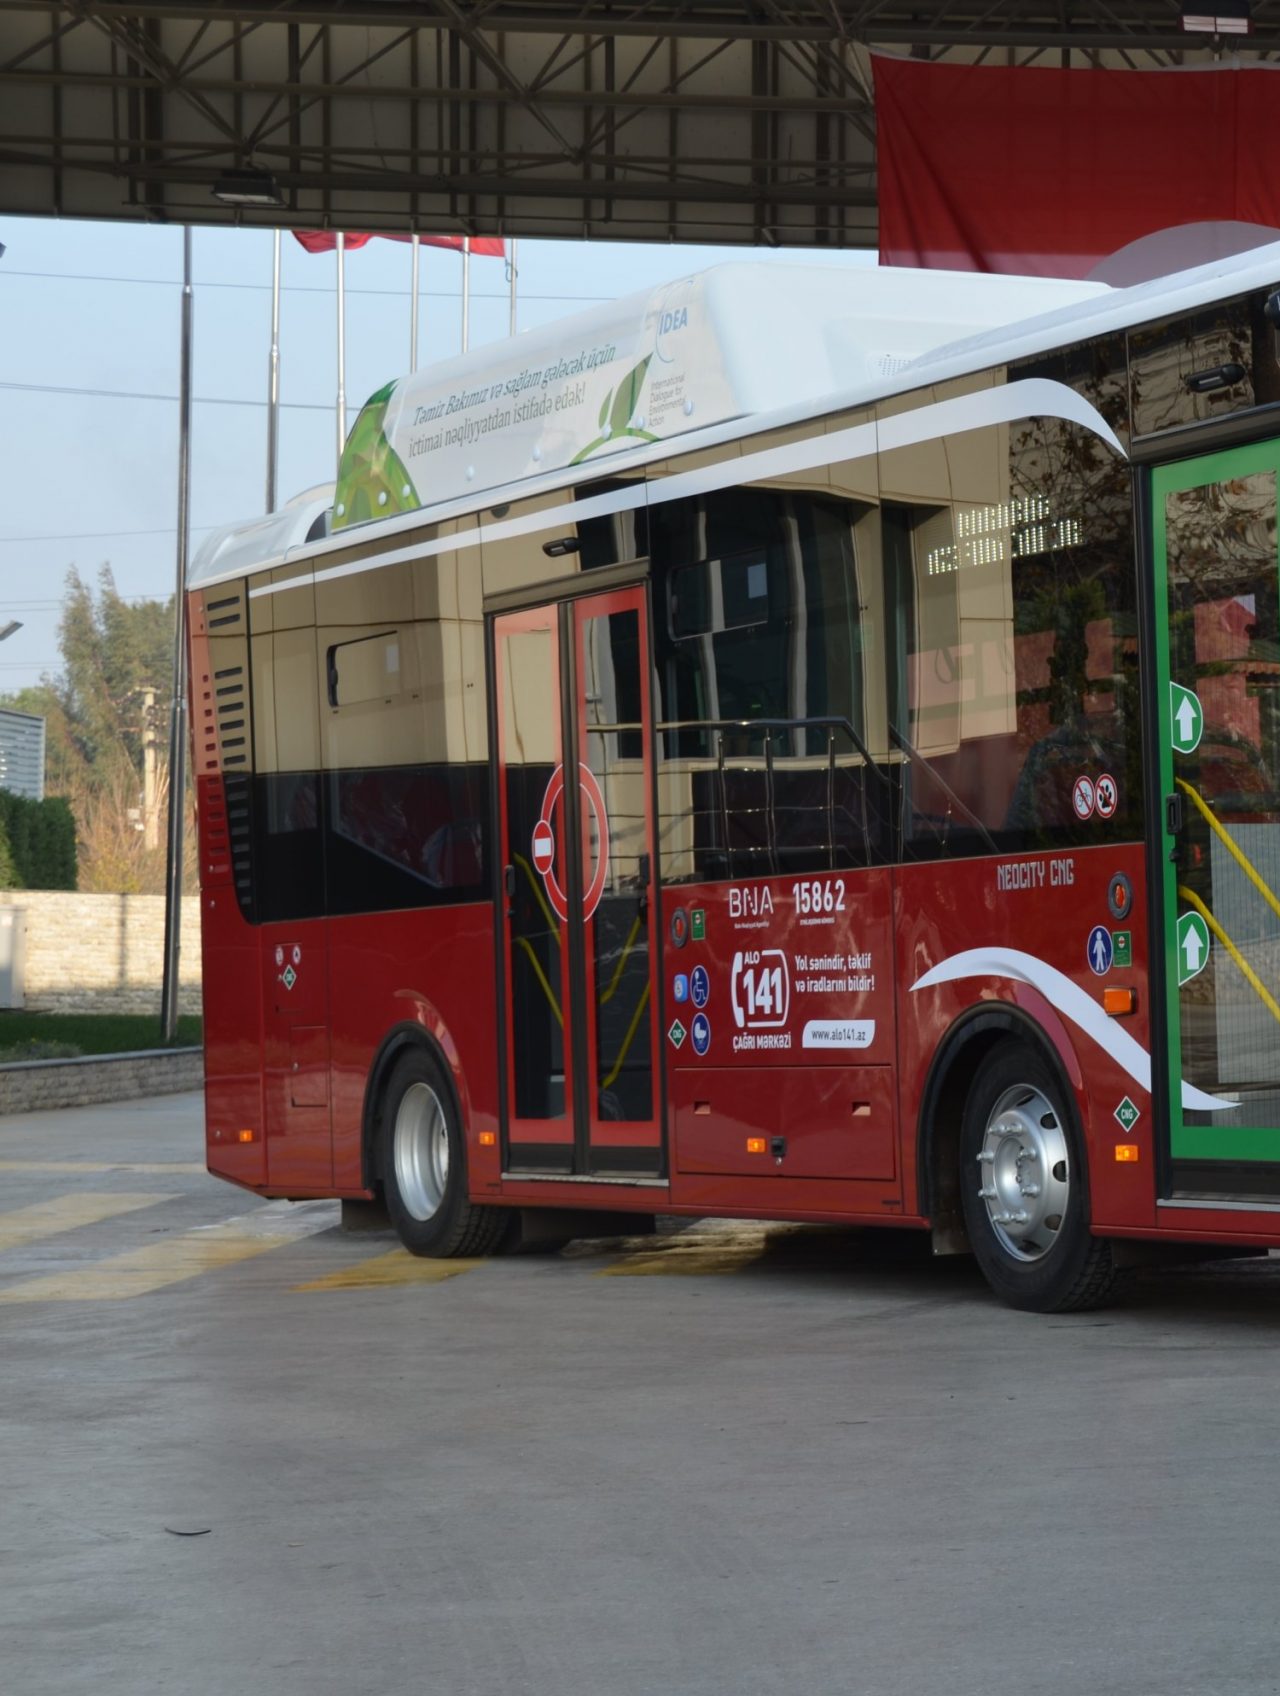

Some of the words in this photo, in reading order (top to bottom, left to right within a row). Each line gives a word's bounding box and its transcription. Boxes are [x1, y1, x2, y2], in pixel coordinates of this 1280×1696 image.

[659, 307, 688, 336] IDEA
[413, 403, 446, 427] Təmiz
[445, 387, 490, 416] Bakımız
[490, 384, 503, 400] və
[503, 369, 543, 398] sağlam
[541, 351, 586, 389] gələcək
[586, 344, 617, 373] üçün
[409, 428, 444, 459] ictimai
[444, 409, 511, 448] nəqliyyatdan
[513, 394, 553, 422] istifadə
[554, 381, 586, 411] edək!
[997, 861, 1046, 891] NEOCITY
[1050, 858, 1075, 886] CNG
[728, 886, 774, 917] BNA
[792, 879, 846, 914] 15862
[744, 950, 760, 965] ALO
[795, 954, 808, 971] Yol
[809, 954, 847, 972] sənindir,
[847, 952, 872, 970] təklif
[742, 966, 783, 1015] 141
[795, 979, 806, 993] və
[806, 976, 847, 993] iradlarını
[848, 974, 875, 991] bildir!
[732, 1031, 755, 1053] ÇAĞRI
[811, 1028, 866, 1042] www.alo141.az
[1120, 1107, 1133, 1120] CNG
